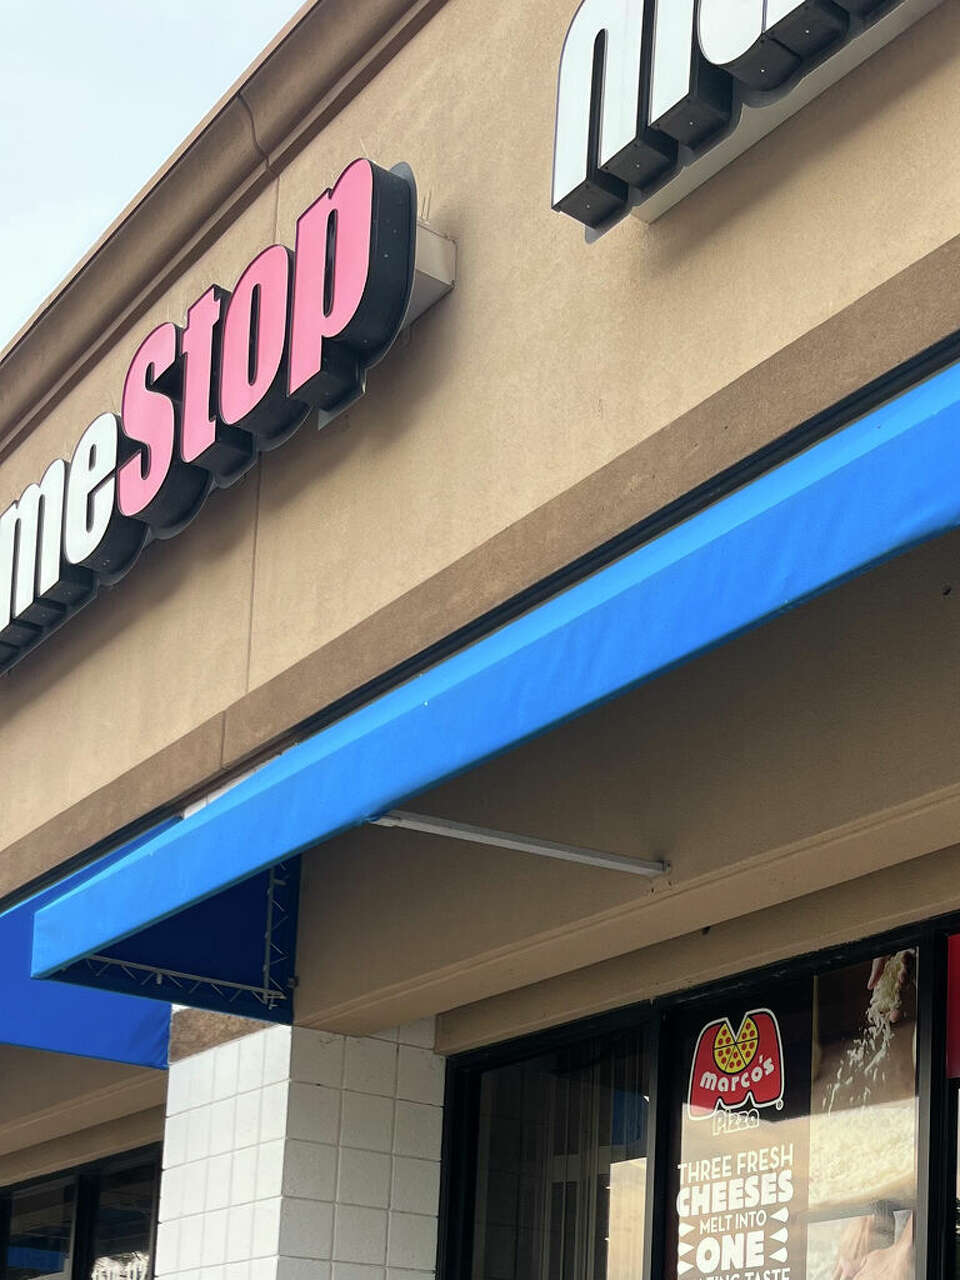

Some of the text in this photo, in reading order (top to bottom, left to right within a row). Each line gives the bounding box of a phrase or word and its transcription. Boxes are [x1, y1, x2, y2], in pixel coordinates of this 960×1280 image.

[677, 1143, 793, 1184] THREE FRESH
[676, 1169, 794, 1217] CHEESES
[700, 1210, 767, 1234] MELT INTO
[696, 1231, 765, 1274] ONE
